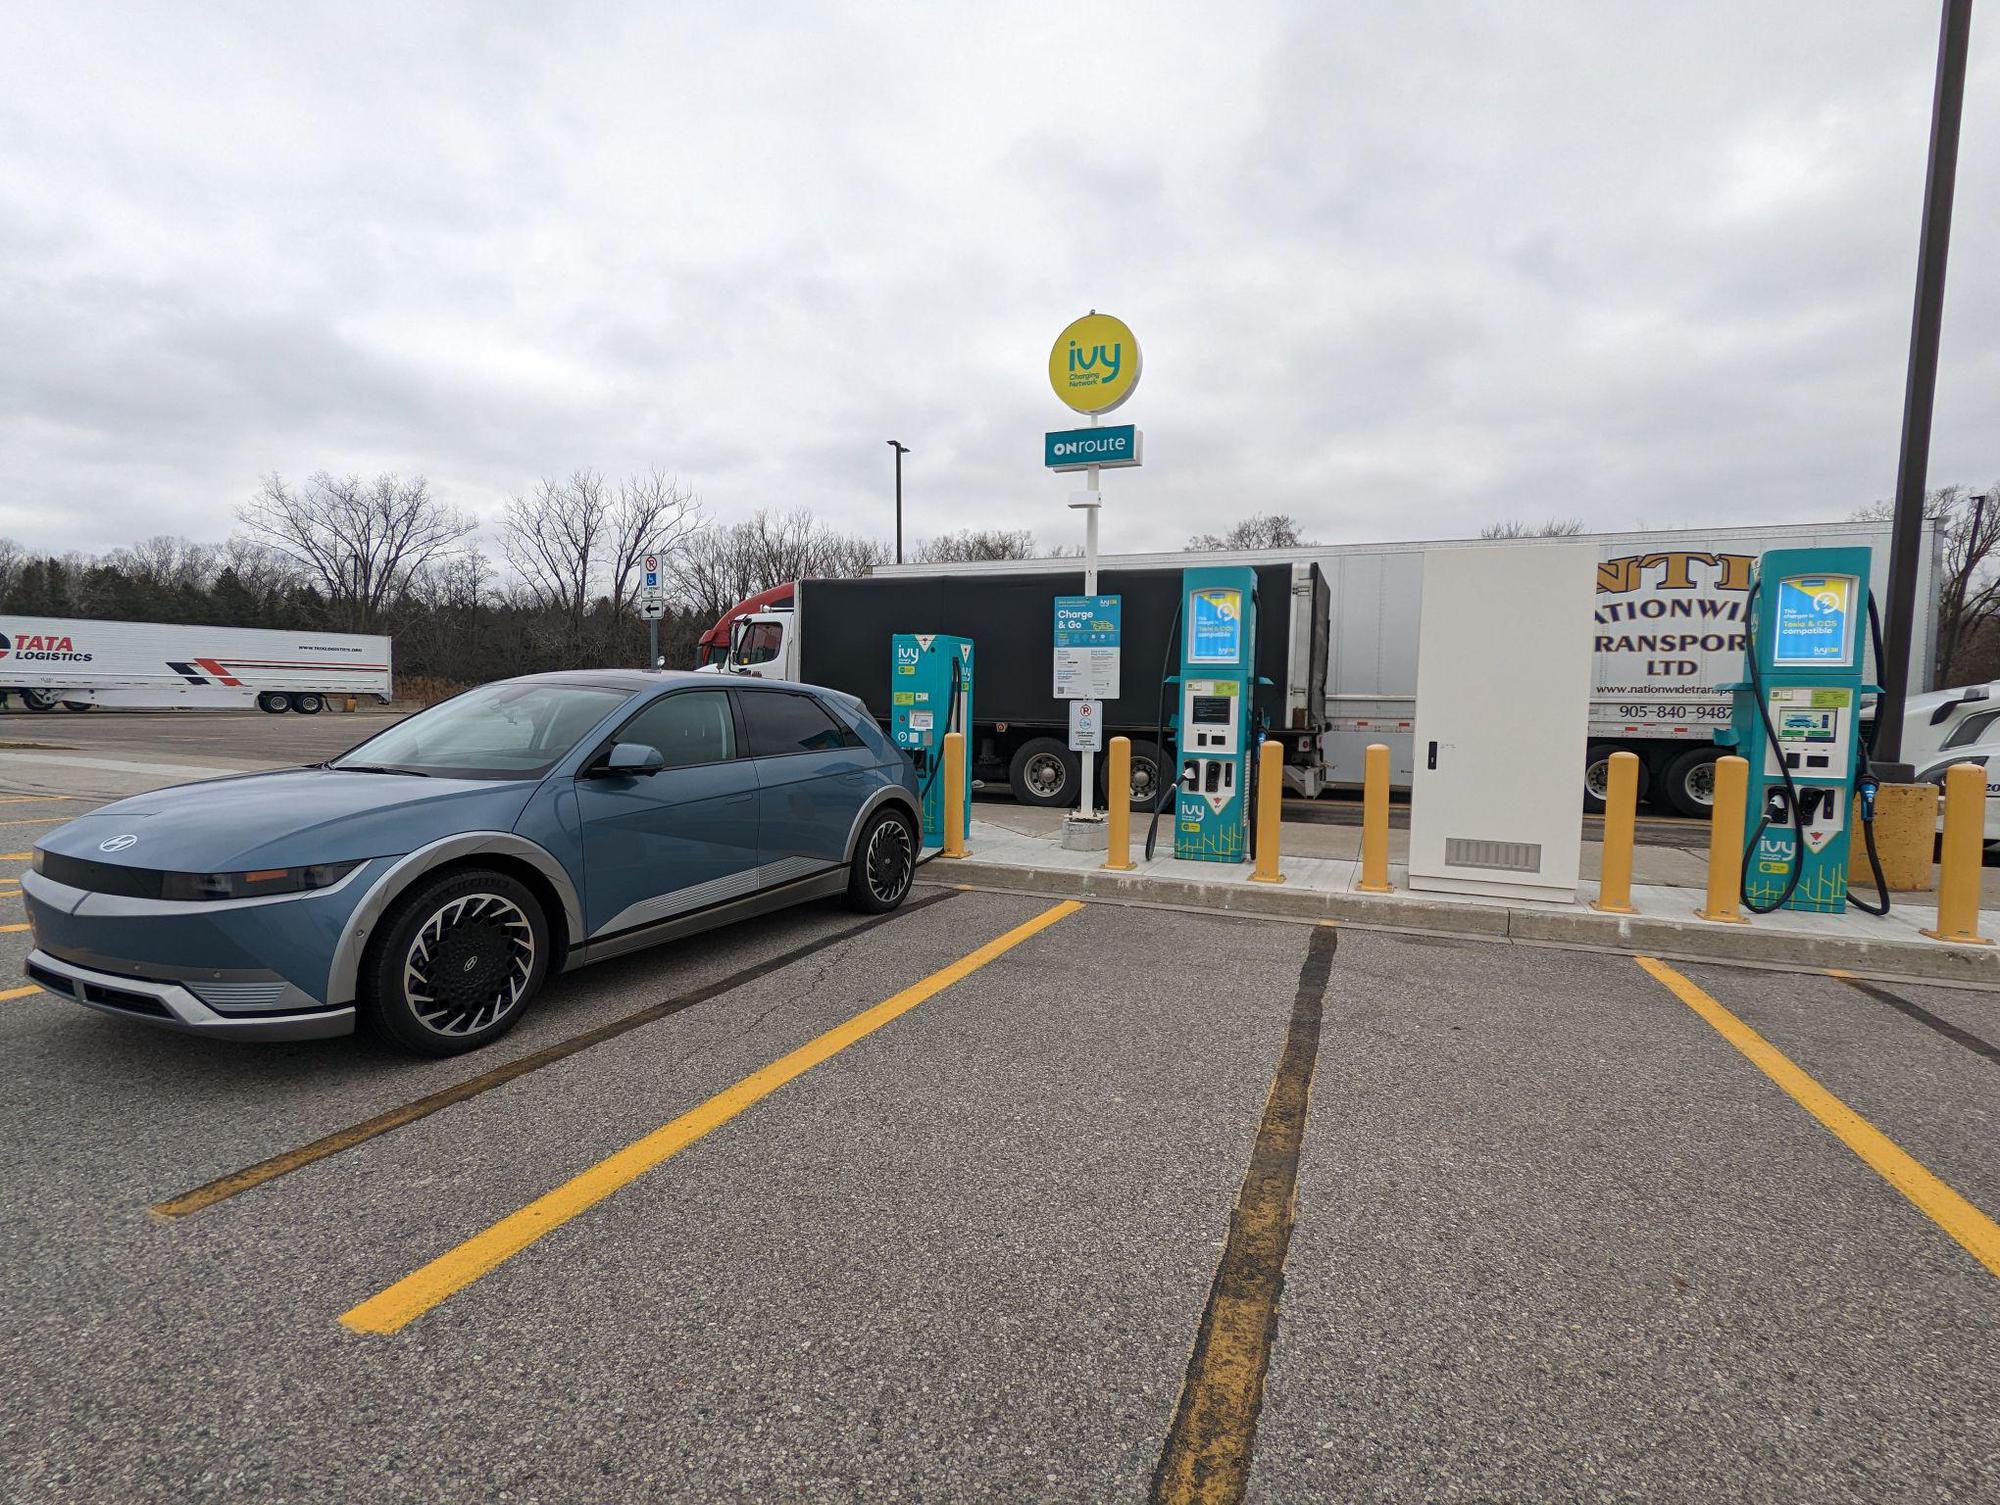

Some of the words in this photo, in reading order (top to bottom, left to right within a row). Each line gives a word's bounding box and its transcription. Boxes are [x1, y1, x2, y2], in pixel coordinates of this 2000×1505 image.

[1069, 340, 1121, 384] ivy
[1069, 373, 1100, 381] Charging
[1058, 610, 1094, 621] Charge
[1058, 621, 1066, 629] &
[1068, 620, 1082, 629] Go
[1782, 628, 1833, 636] compatible
[15, 635, 74, 652] TATA
[16, 651, 93, 662] LOGISTICS
[898, 644, 920, 664] ivy
[1646, 660, 1699, 677] LTD
[1619, 705, 1734, 720] 905-840-9487
[1181, 801, 1205, 822] ivy
[1760, 835, 1797, 861] ivy
